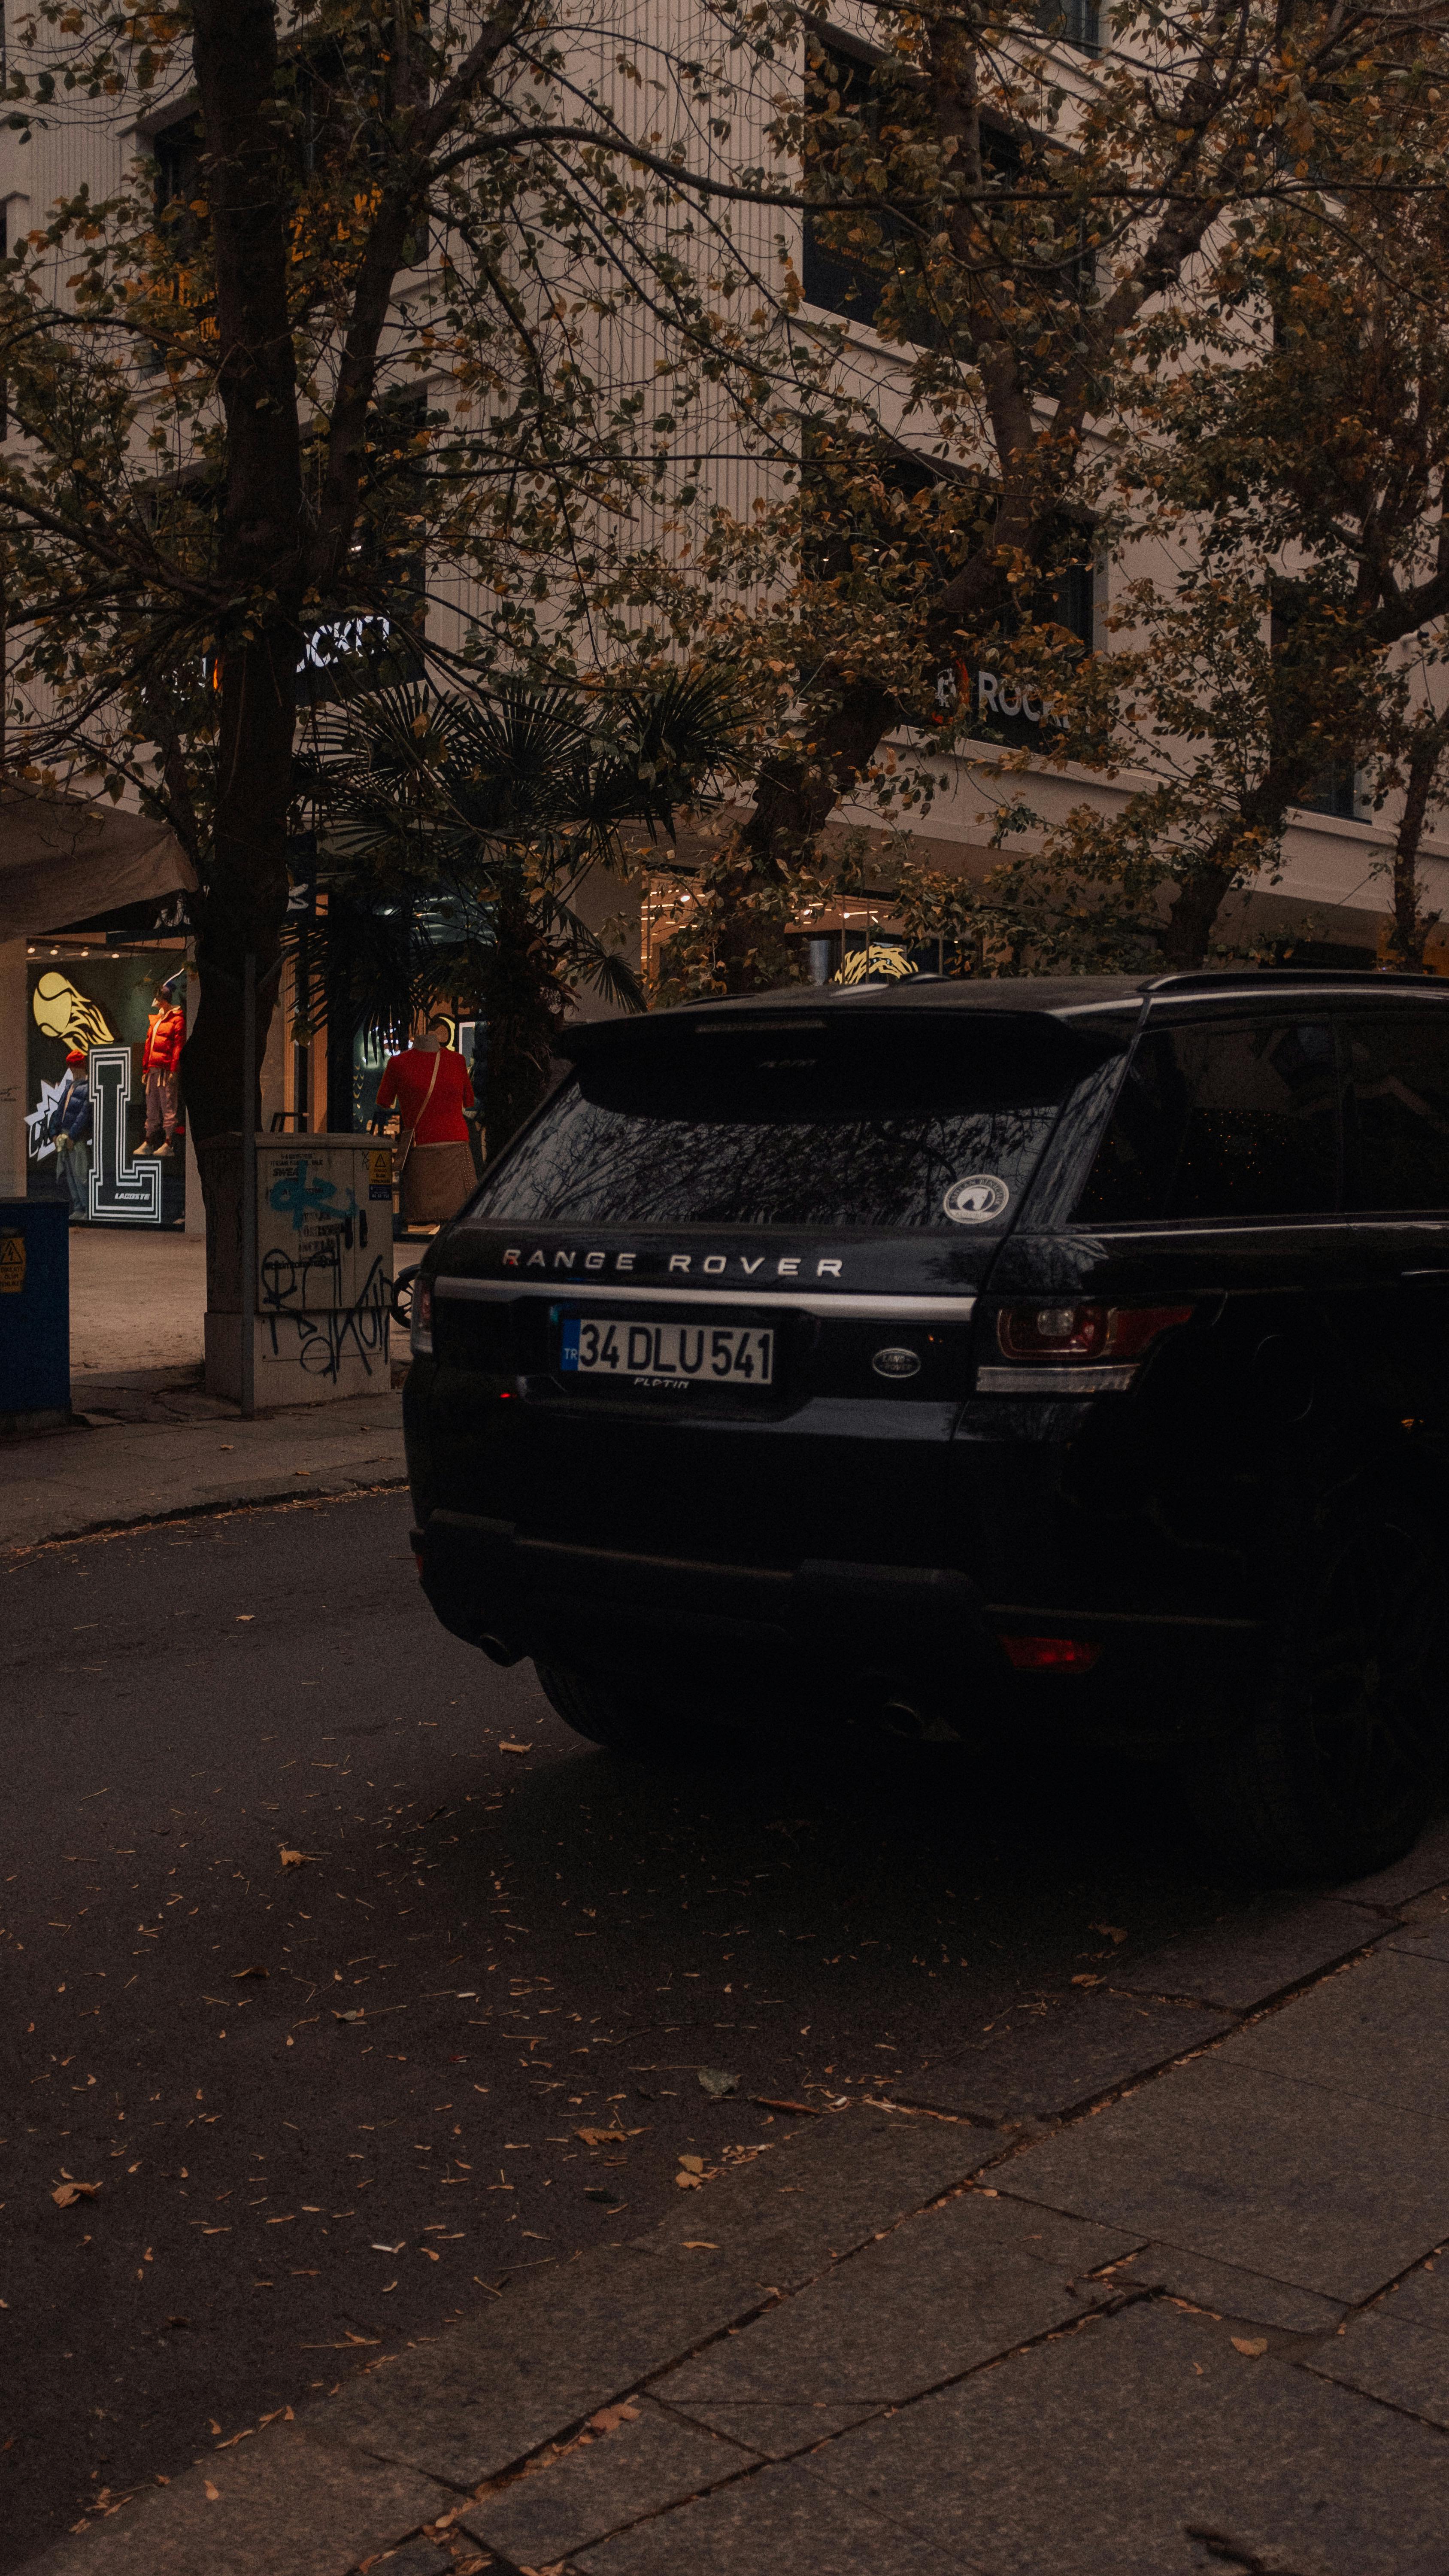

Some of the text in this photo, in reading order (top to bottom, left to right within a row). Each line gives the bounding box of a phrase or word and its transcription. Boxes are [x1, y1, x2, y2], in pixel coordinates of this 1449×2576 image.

[114, 1192, 151, 1201] LACOSTE
[502, 1249, 844, 1277] RANGE ROVER
[564, 1347, 578, 1360] TR
[580, 1324, 771, 1380] 34 DLU 541
